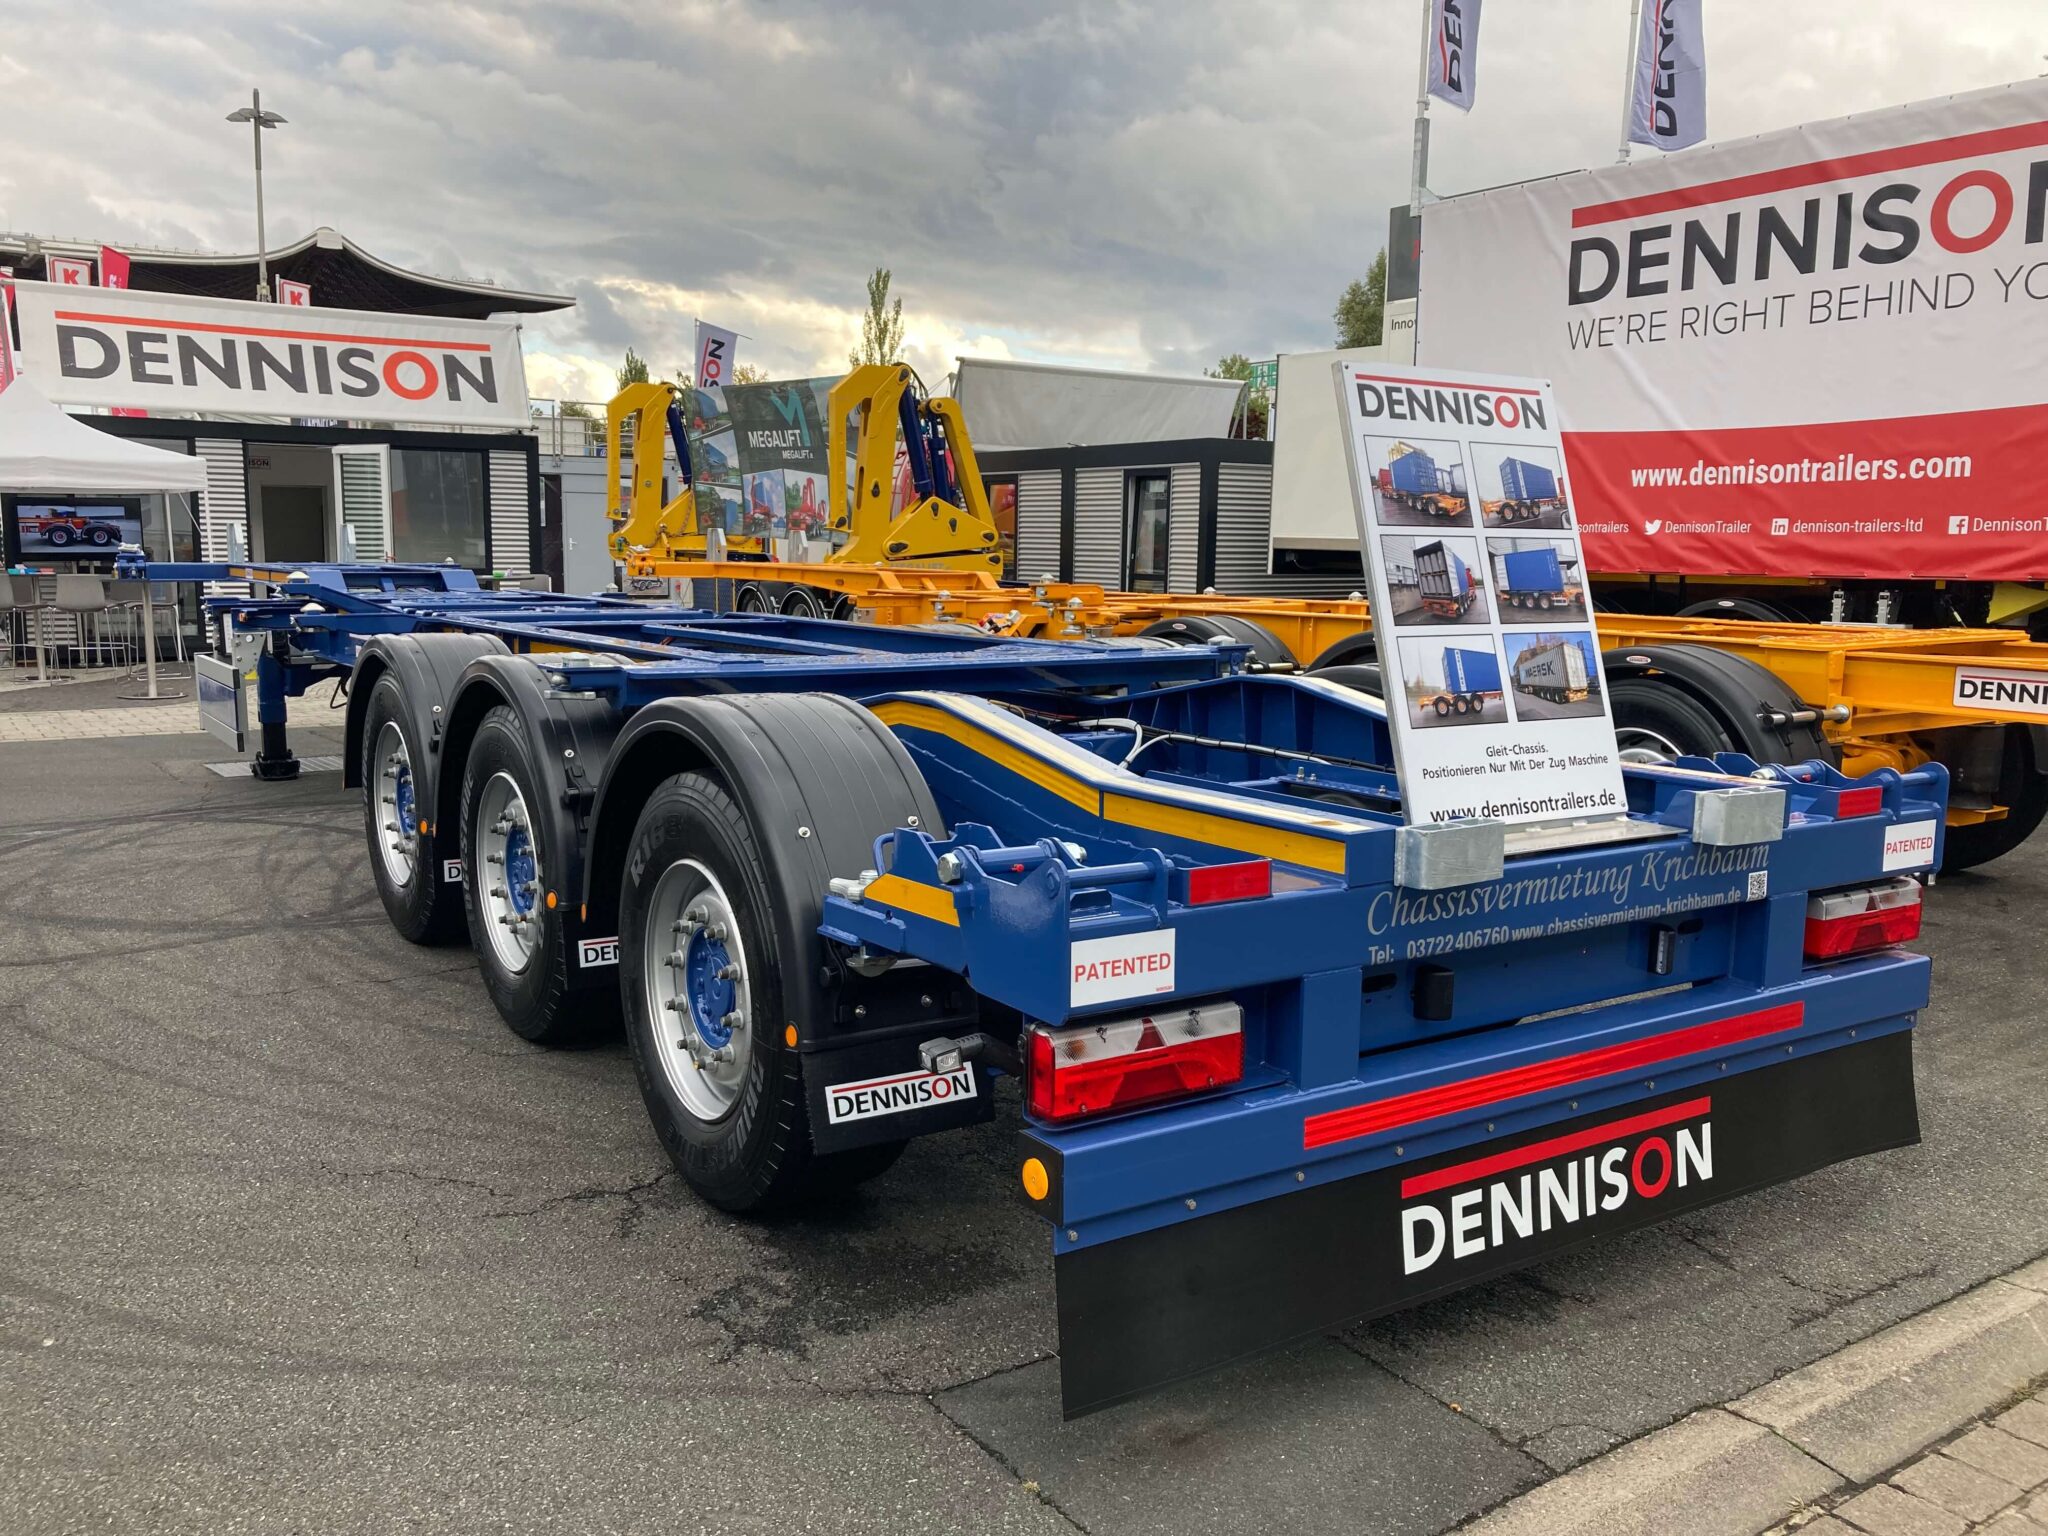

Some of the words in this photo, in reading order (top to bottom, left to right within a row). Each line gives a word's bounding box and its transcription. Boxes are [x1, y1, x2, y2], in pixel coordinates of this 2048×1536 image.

[1681, 294, 1795, 339] RIGHT
[1809, 272, 1975, 325] BEHIND
[1391, 318, 1416, 331] Inno
[56, 324, 498, 403] DENNISON
[1356, 382, 1547, 430] DENNISON
[748, 429, 801, 448] MEGALIFT
[1631, 452, 1972, 488] www.dennisontrailers.com
[1665, 520, 1752, 534] DennisonTrailer
[1793, 518, 1924, 534] dennison-trailers-ltd
[1525, 661, 1555, 678] MAERSK
[1960, 679, 2048, 704] DENNI
[1486, 742, 1549, 758] Gleit-Chassis.
[1422, 764, 1486, 780] Positionieren
[1489, 762, 1506, 773] Nur
[1510, 759, 1526, 772] Mit
[1529, 758, 1545, 770] Der
[1549, 757, 1566, 770] Zug
[1569, 753, 1608, 767] Maschine
[1430, 788, 1616, 822] www.dennisontrailers.de
[1886, 836, 1933, 855] PATENTED
[1367, 864, 1633, 936] Chassisvermietung
[1641, 843, 1770, 892] Krichbaum
[1074, 952, 1171, 982] PATENTED
[1368, 944, 1395, 965] Tel:
[833, 1073, 971, 1118] DENNISON
[1402, 1121, 1713, 1276] DENNISON
